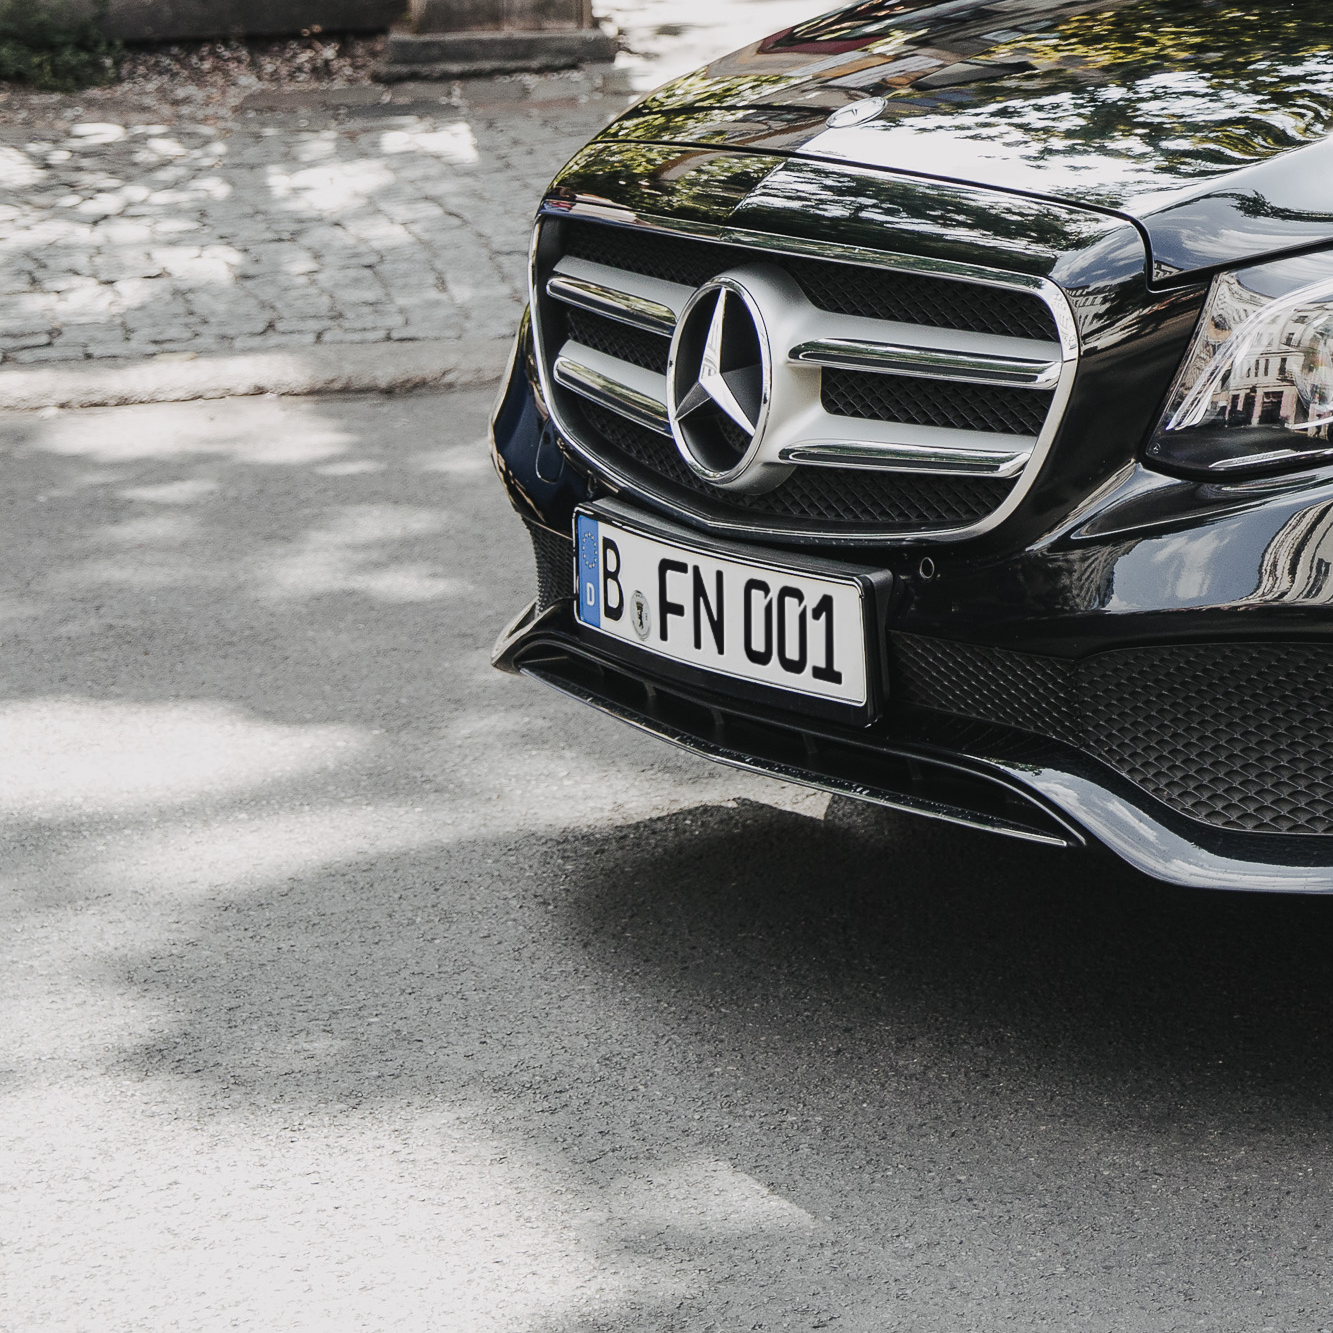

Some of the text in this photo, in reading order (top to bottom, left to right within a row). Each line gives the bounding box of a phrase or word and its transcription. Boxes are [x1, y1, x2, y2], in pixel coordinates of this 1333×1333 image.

[586, 582, 595, 606] D
[602, 535, 843, 685] B FN 001
